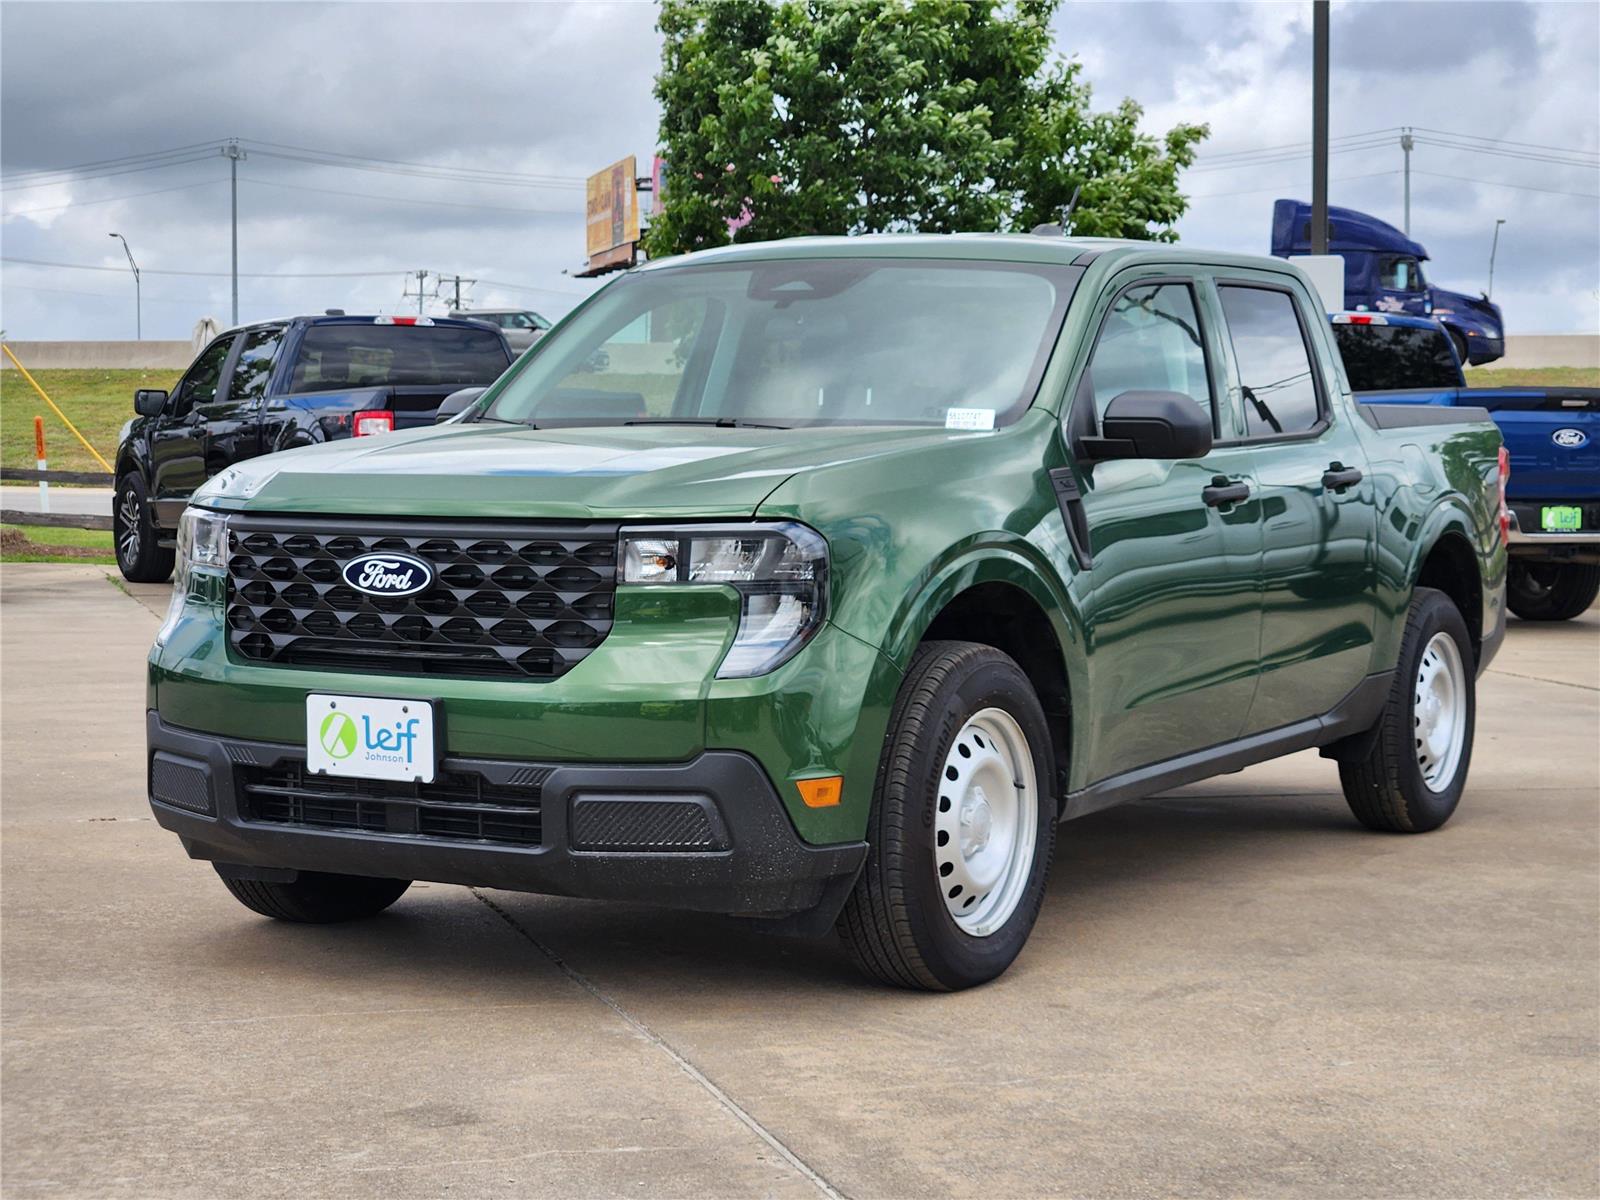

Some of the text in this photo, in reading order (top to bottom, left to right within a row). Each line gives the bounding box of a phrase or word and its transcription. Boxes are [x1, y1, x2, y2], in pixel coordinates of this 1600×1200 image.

[359, 560, 413, 589] Ford
[362, 715, 419, 763] leif
[365, 752, 404, 763] Johnson
